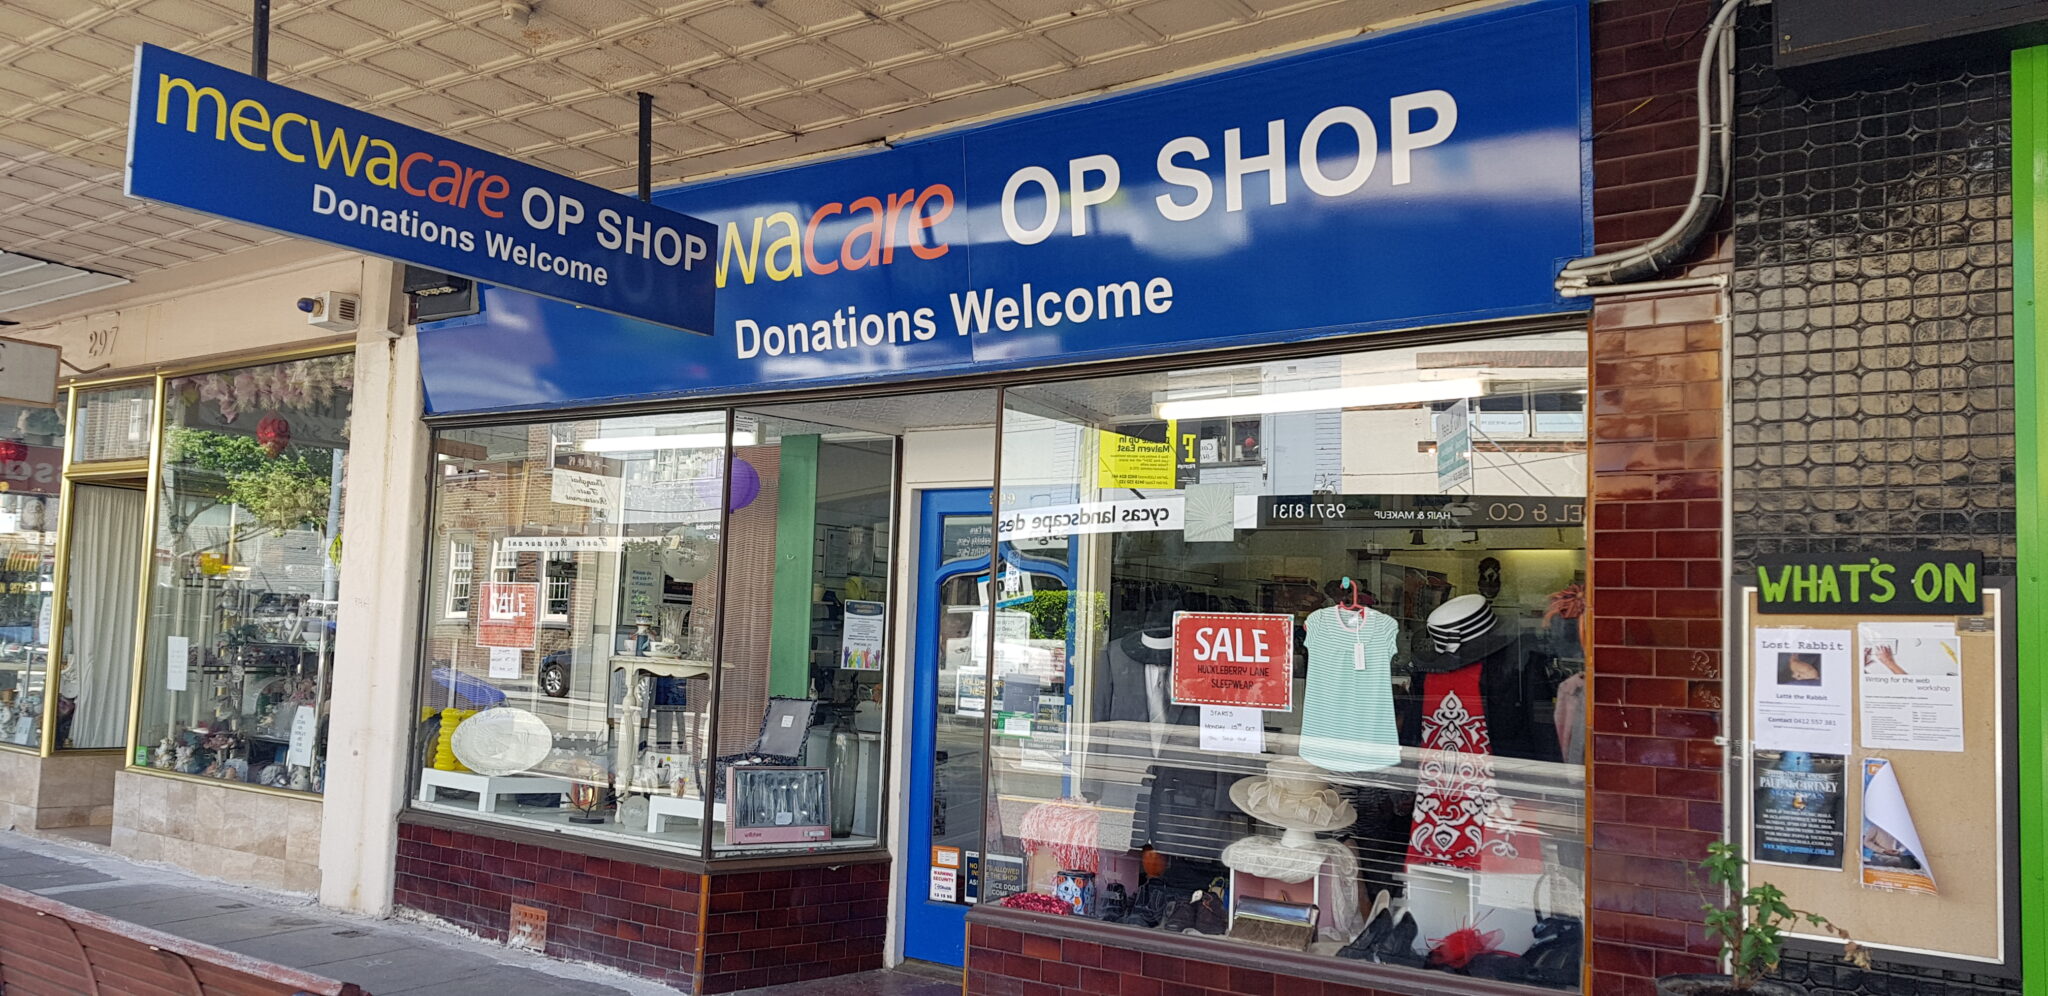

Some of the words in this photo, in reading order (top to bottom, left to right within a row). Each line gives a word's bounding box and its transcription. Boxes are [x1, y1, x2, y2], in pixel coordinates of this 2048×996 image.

[155, 73, 510, 218] mecwacare
[520, 187, 584, 236] OP
[596, 209, 707, 271] SHOP
[1000, 152, 1120, 246] OP
[1154, 89, 1459, 223] SHOP
[312, 183, 476, 252] Donations
[484, 230, 608, 286] Welcome
[734, 299, 936, 361] Donations
[949, 277, 1174, 338] Welcome
[89, 327, 119, 357] 297
[1758, 558, 1896, 604] WHAT'S
[1913, 562, 1976, 603] ON
[1193, 627, 1271, 663] SALE
[1761, 640, 1791, 650] Lost
[1798, 641, 1844, 651] Rabbit
[1197, 664, 1248, 676] HUCKLEBERRY
[1249, 666, 1270, 677] LANE
[1865, 676, 1889, 684] Writing
[1211, 679, 1254, 690] SLEEPWEAR
[993, 865, 1020, 875] ALLOWED
[1002, 873, 1018, 881] SHOP
[1003, 883, 1020, 892] DOGS
